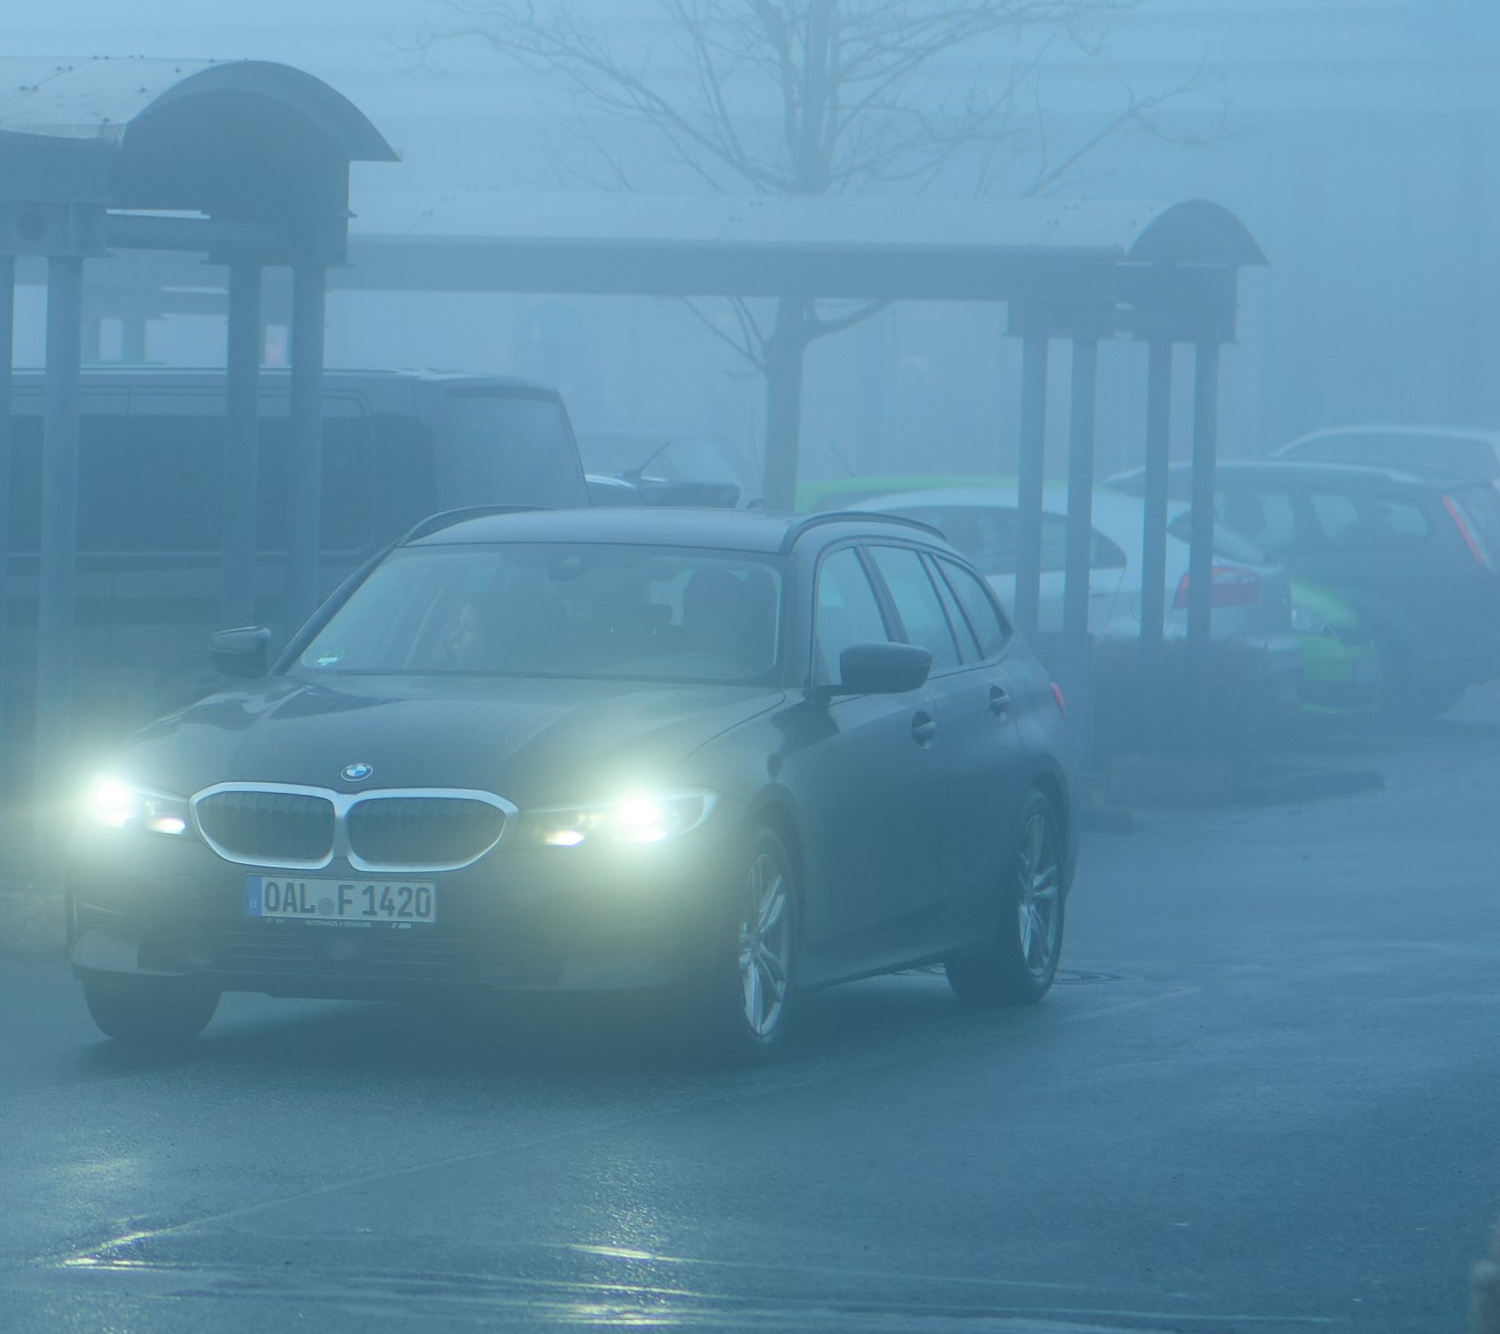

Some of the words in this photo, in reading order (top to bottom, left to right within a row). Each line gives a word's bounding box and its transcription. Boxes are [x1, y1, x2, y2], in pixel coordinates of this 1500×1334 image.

[264, 881, 316, 914] OAL
[338, 884, 355, 915] F
[361, 885, 431, 917] 1420
